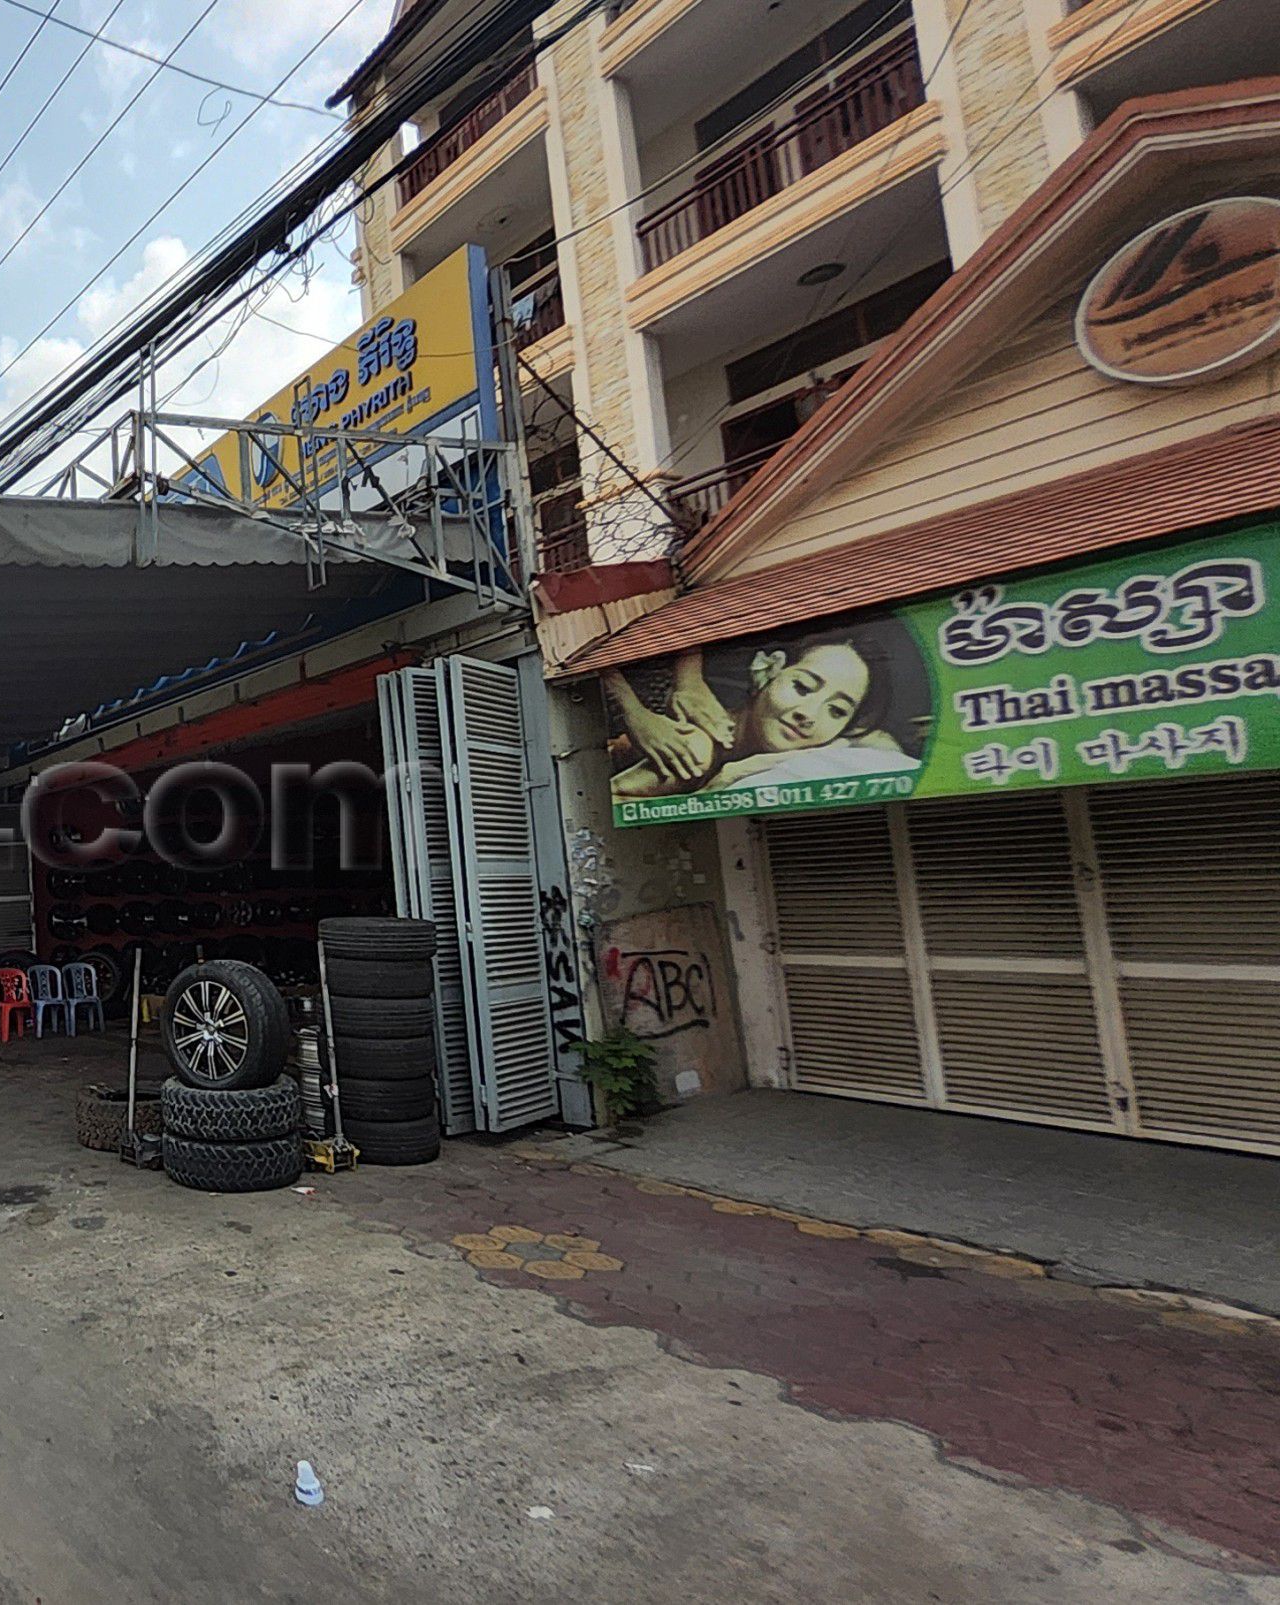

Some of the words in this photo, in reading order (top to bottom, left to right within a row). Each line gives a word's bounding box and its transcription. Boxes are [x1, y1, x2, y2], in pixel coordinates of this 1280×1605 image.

[341, 371, 413, 431] PHYRITH
[959, 678, 1075, 727] Thai
[970, 740, 1054, 777] 타이
[1082, 719, 1242, 767] 마사지
[779, 786, 815, 806] 011
[820, 781, 860, 801] 427
[866, 776, 913, 796] 770
